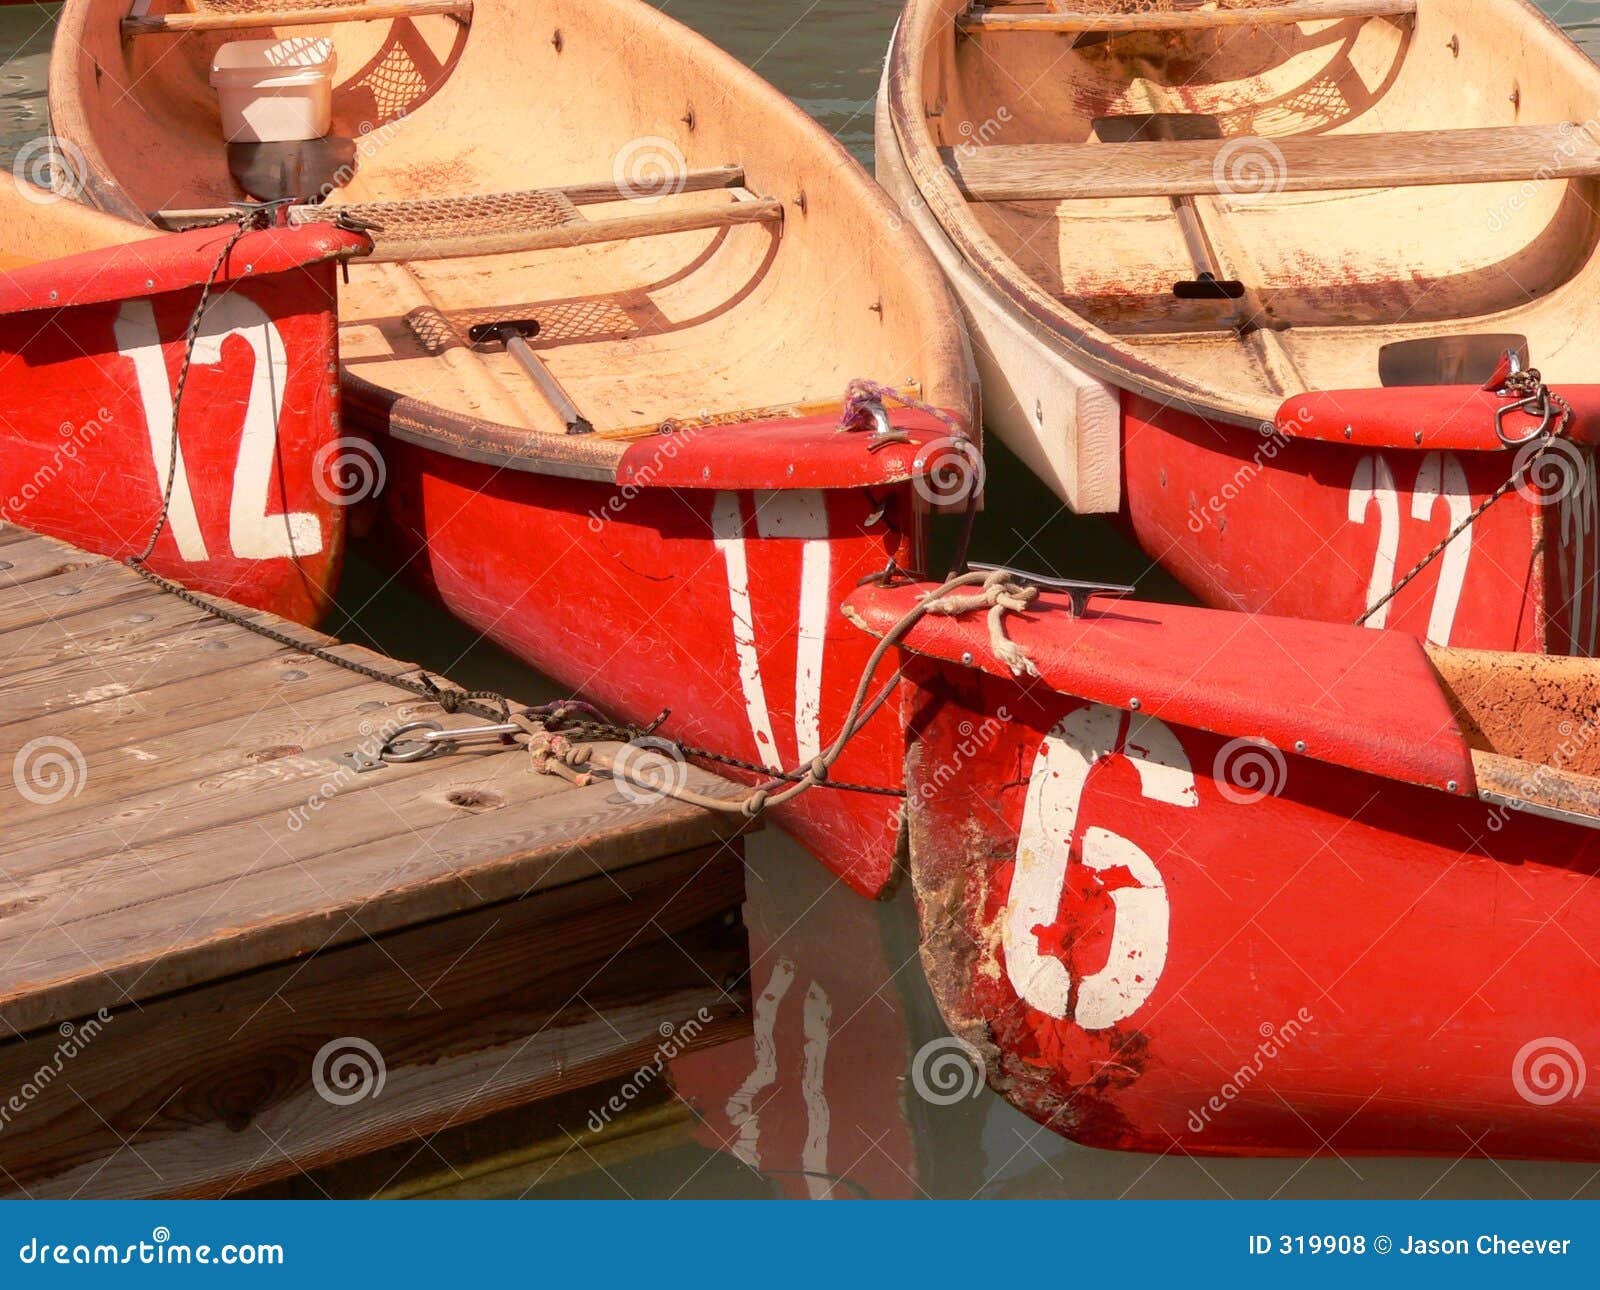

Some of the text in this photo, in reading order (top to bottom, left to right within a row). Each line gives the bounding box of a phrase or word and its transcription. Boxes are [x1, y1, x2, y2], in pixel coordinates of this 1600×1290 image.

[113, 290, 322, 561] 12
[711, 489, 831, 783] 17
[1005, 703, 1199, 1030] 6
